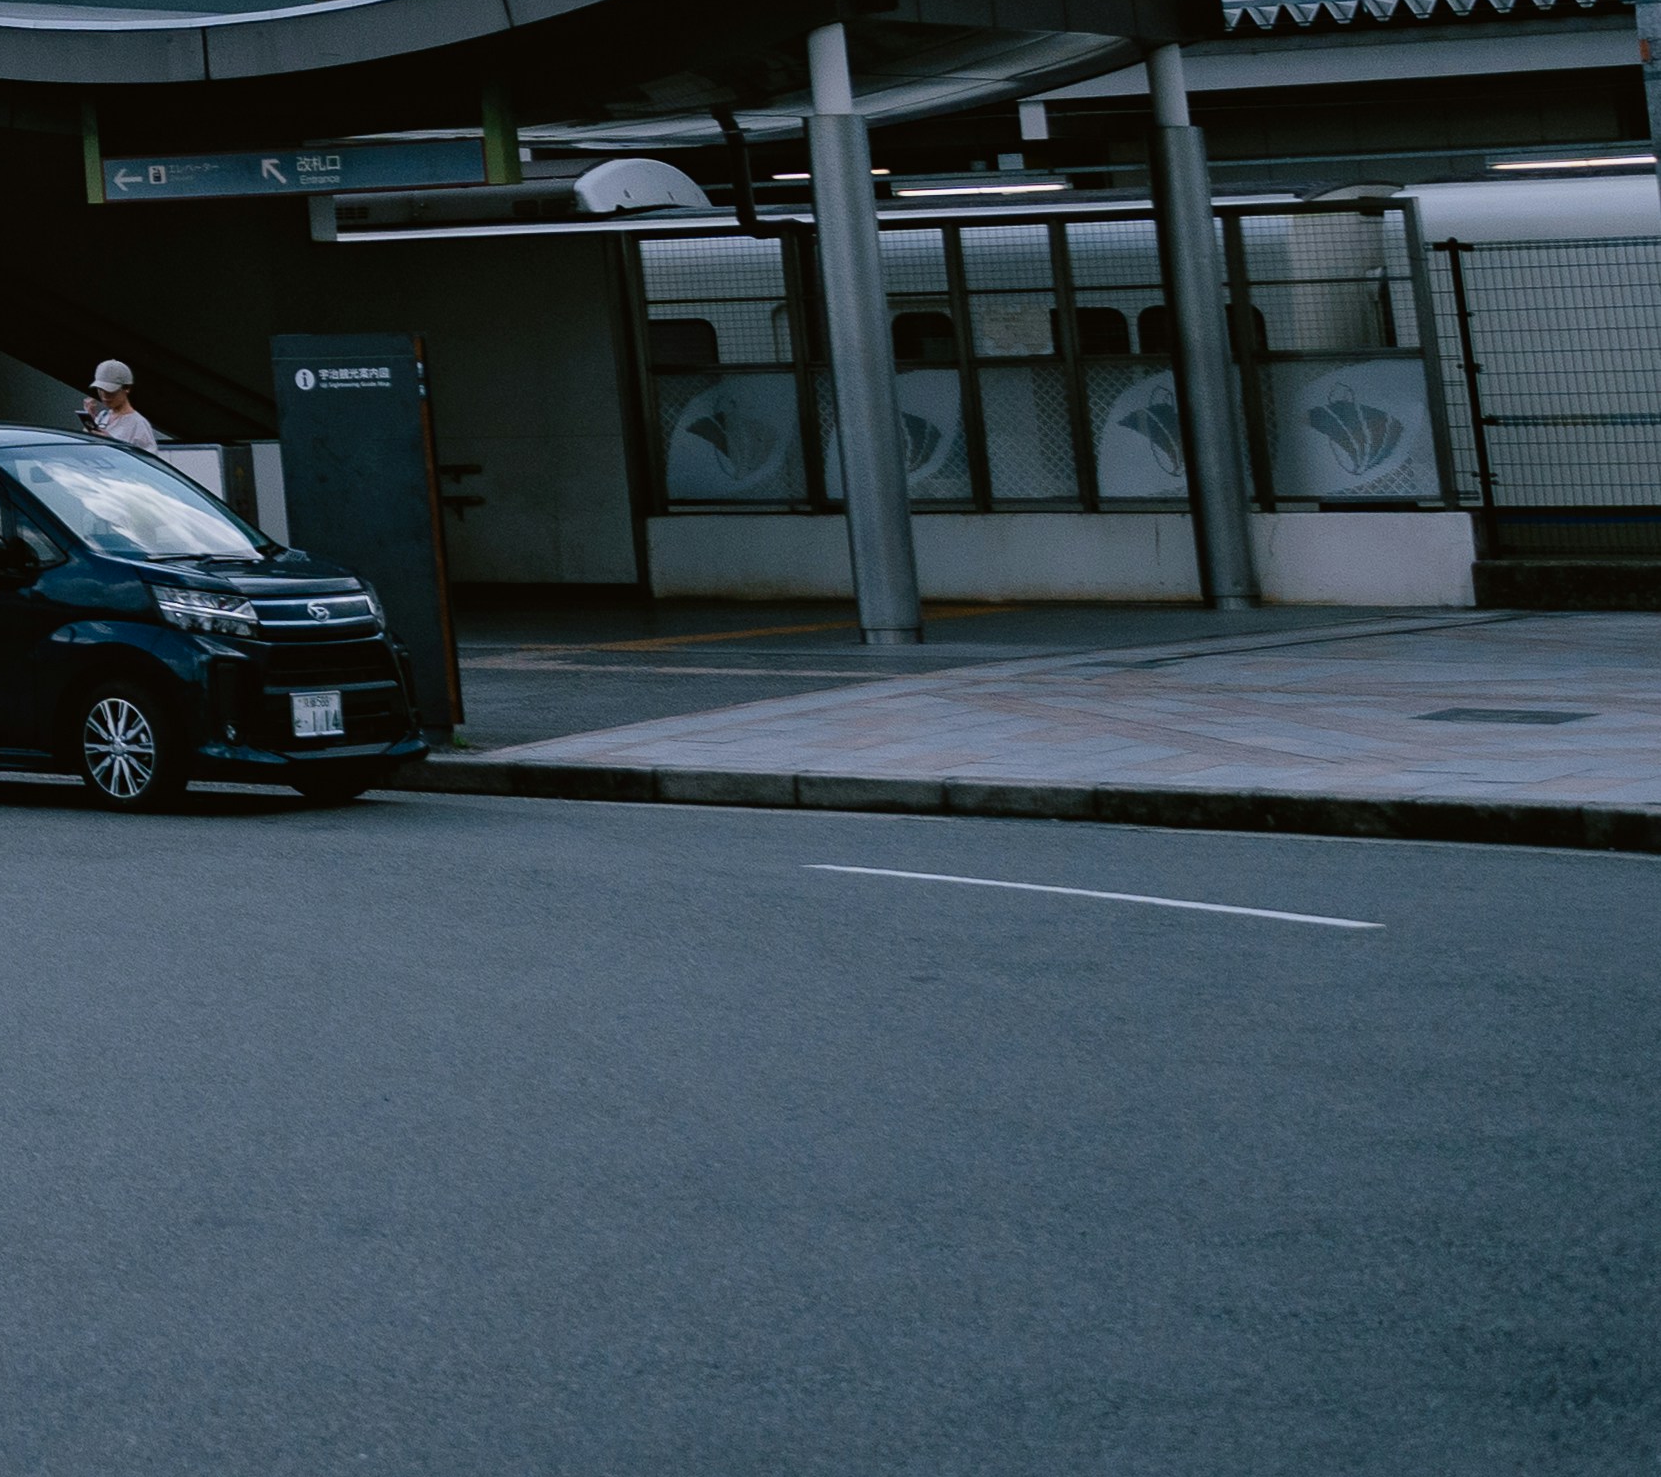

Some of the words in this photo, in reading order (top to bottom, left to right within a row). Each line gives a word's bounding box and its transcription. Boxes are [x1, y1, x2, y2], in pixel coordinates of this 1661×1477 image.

[296, 156, 341, 173] 改札口
[300, 174, 340, 185] Entrance
